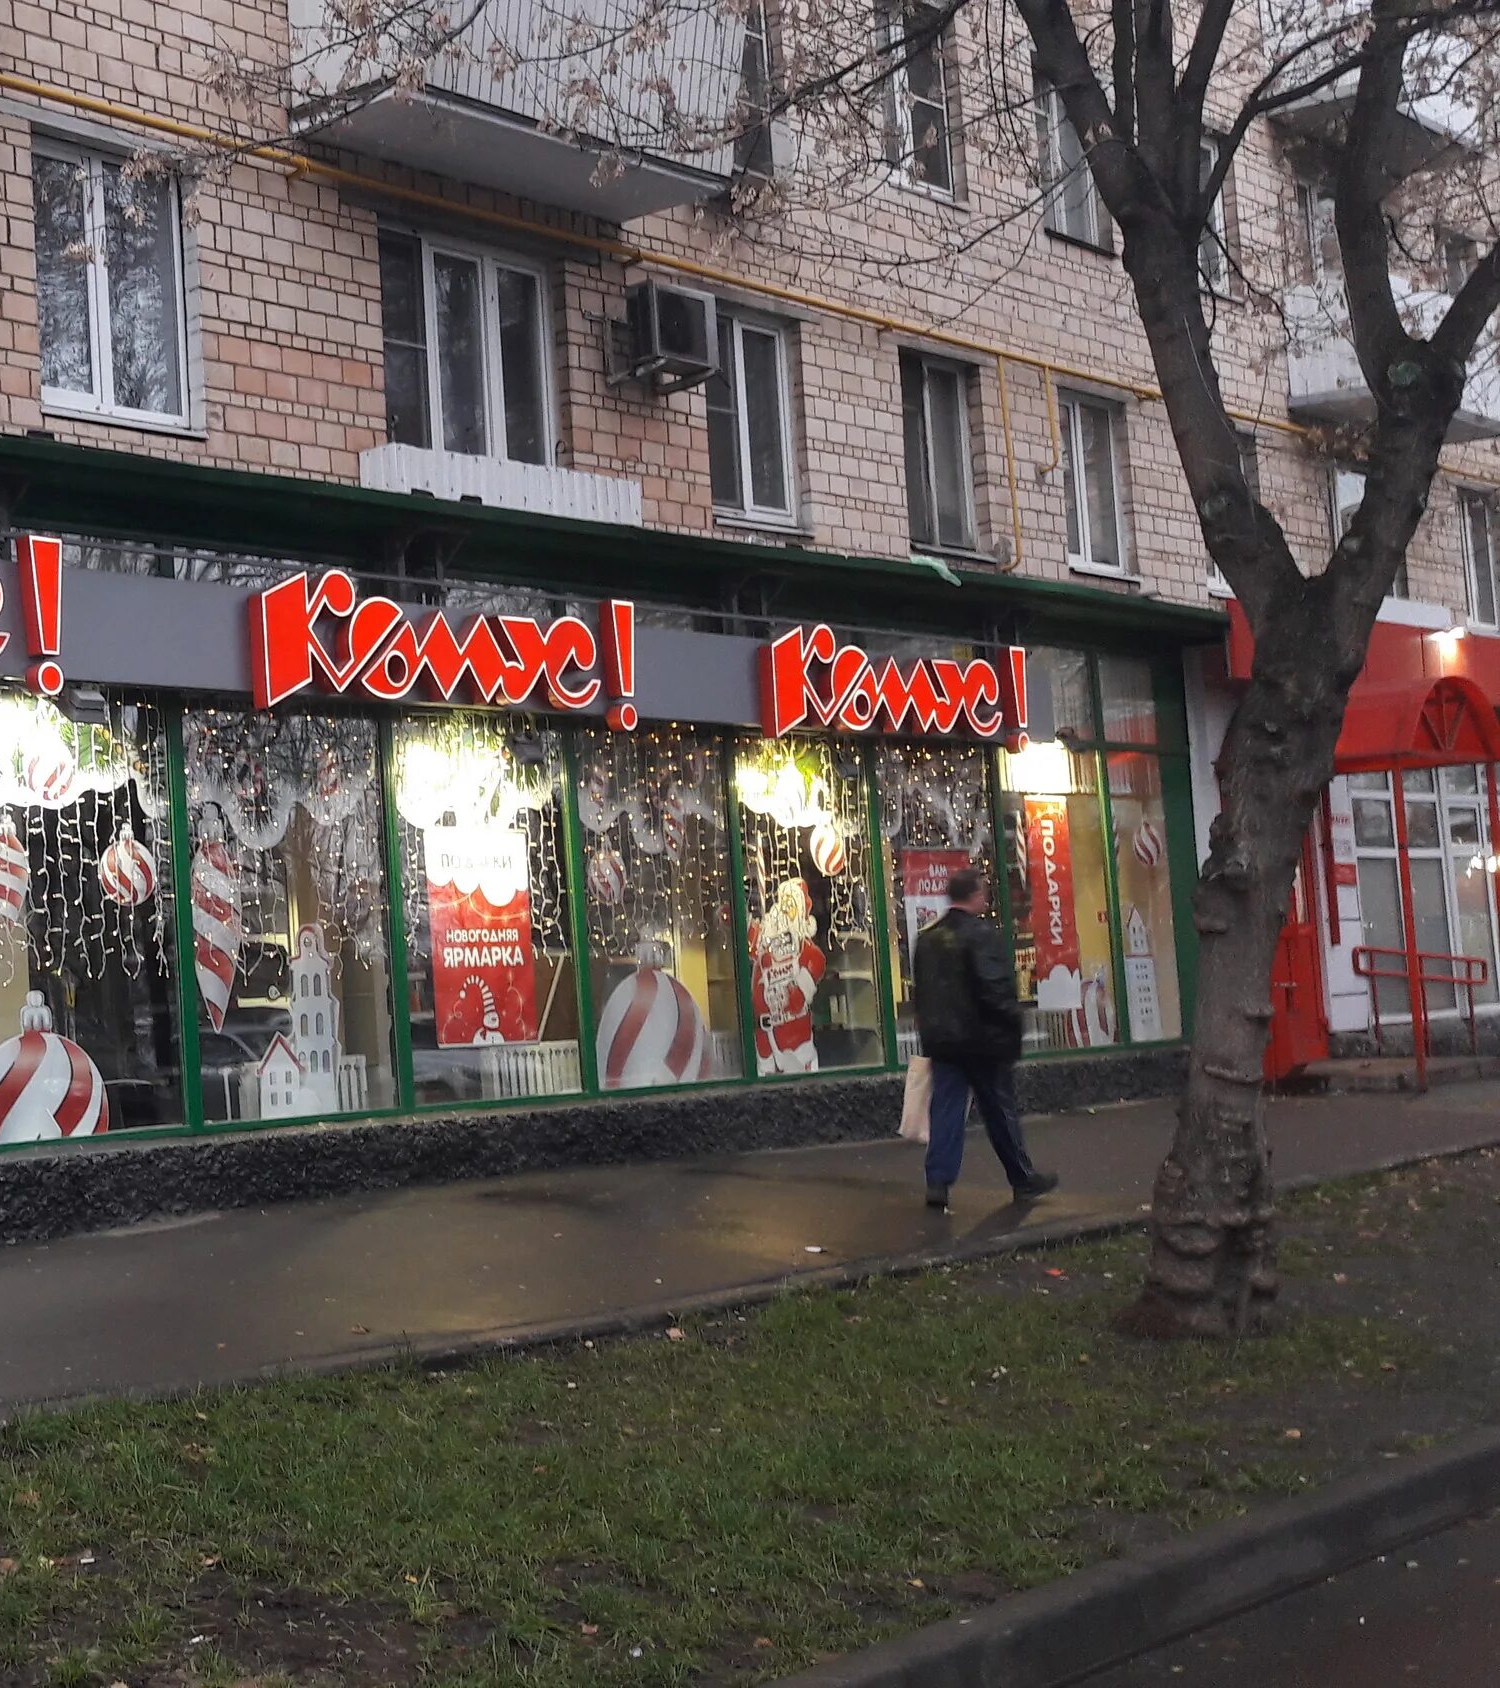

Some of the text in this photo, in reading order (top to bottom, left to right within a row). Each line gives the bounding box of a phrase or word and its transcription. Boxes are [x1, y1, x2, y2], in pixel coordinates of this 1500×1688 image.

[929, 863, 948, 878] ВАМ
[1040, 819, 1064, 946] ПОДАРКИ
[446, 928, 519, 943] НОВОГОДНЯЯ
[443, 945, 525, 968] ЯРМАРКА
